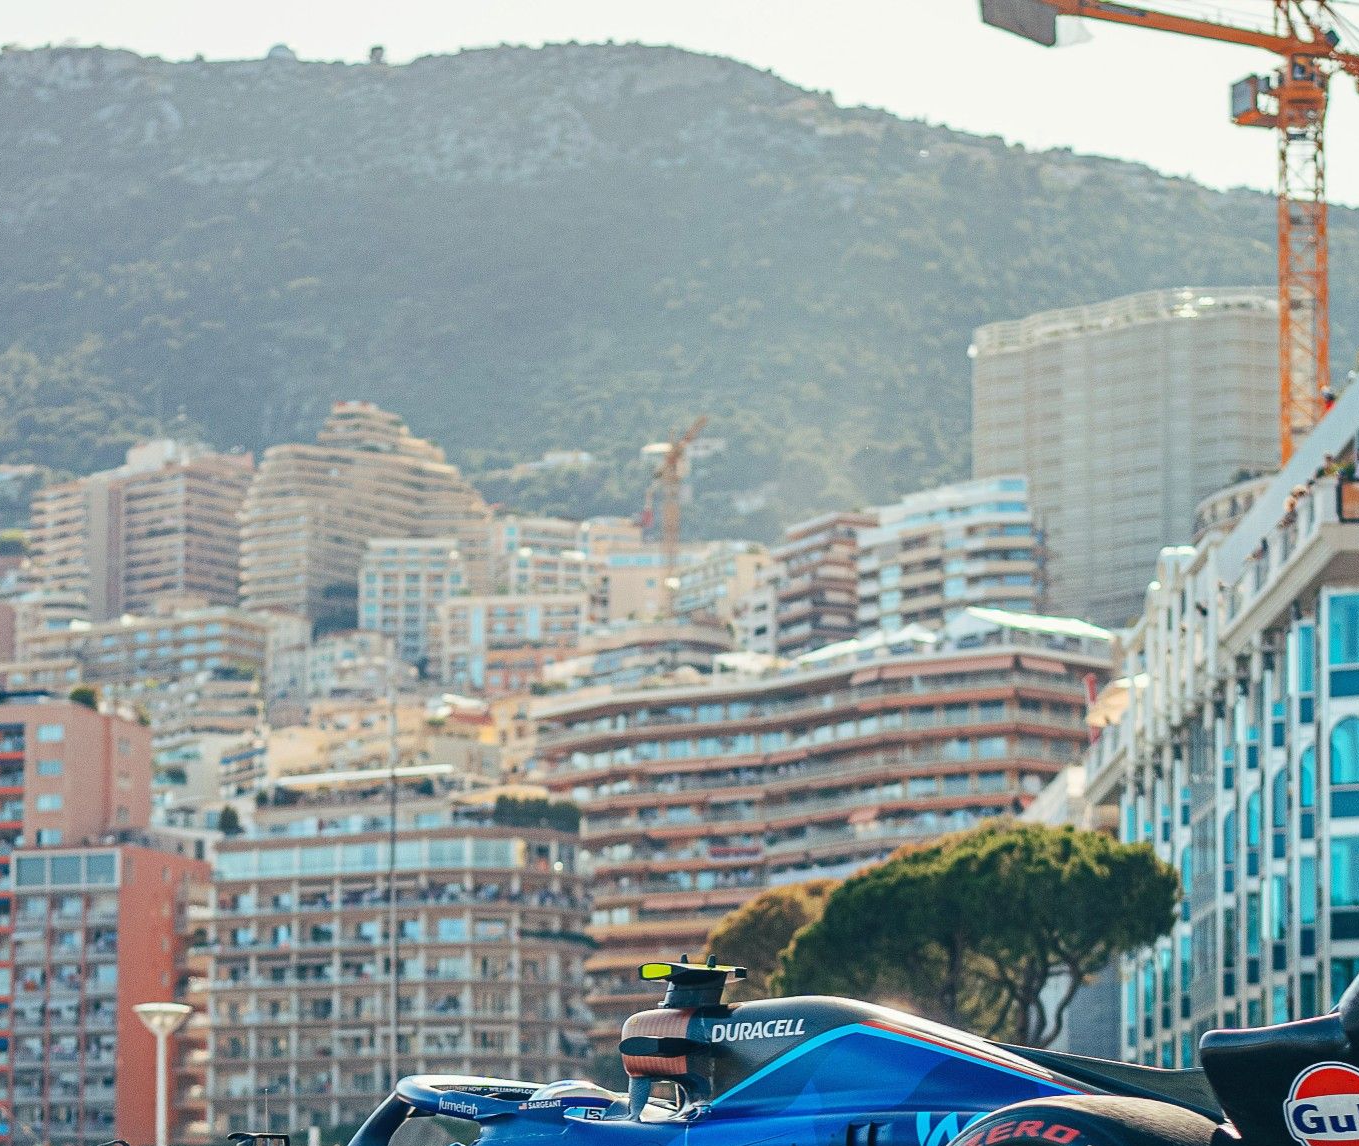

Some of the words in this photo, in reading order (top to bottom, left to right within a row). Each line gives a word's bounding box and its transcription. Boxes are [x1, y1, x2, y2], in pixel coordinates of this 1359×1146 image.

[712, 1019, 805, 1042] DURACELL
[439, 1097, 478, 1115] Jumeirah
[528, 1100, 562, 1109] SARGEANT
